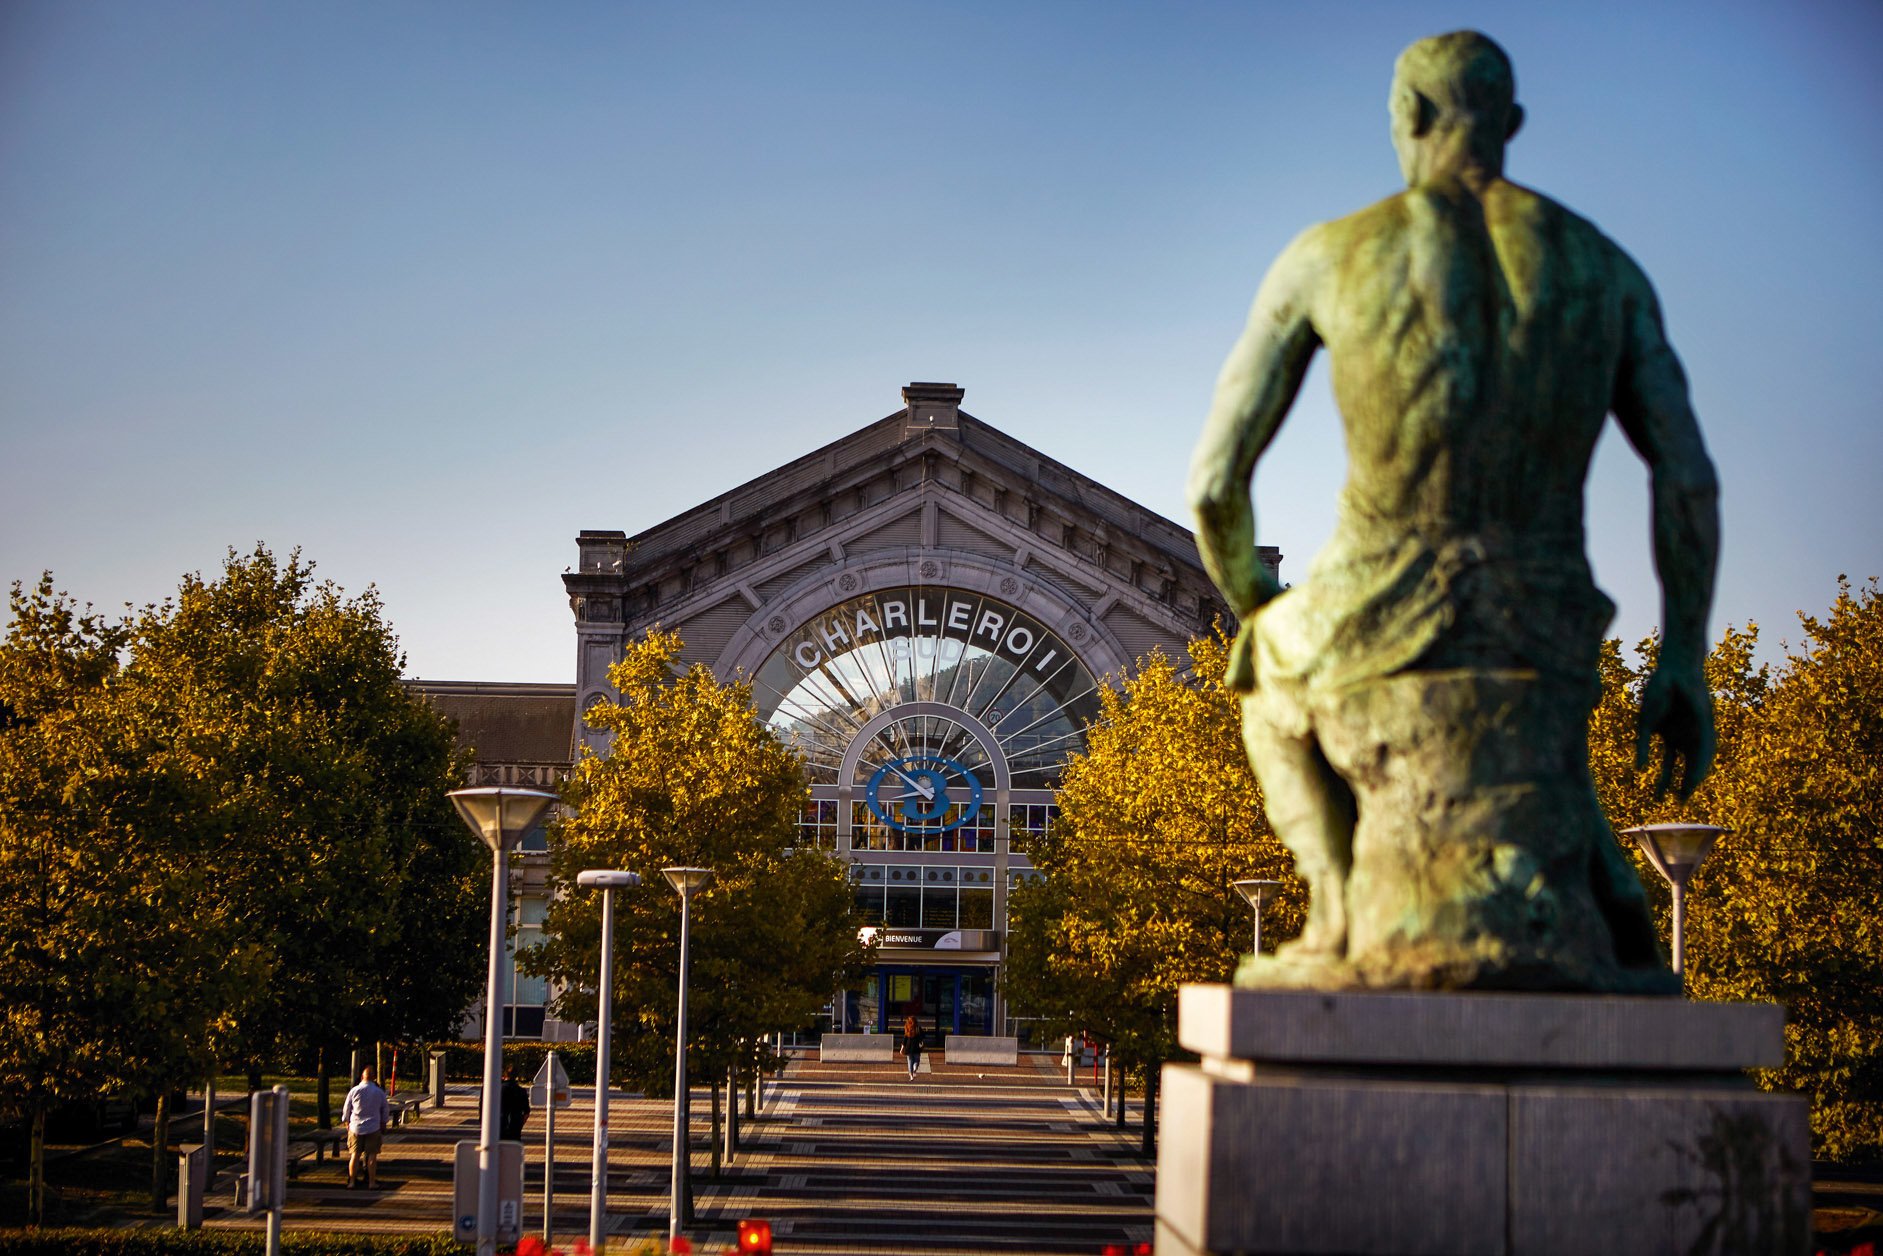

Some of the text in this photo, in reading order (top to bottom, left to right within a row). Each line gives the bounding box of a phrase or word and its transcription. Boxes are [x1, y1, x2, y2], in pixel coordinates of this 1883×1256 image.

[795, 599, 1057, 672] CHARLEROI
[890, 634, 963, 662] SUD
[885, 935, 922, 943] BIENVENUE
